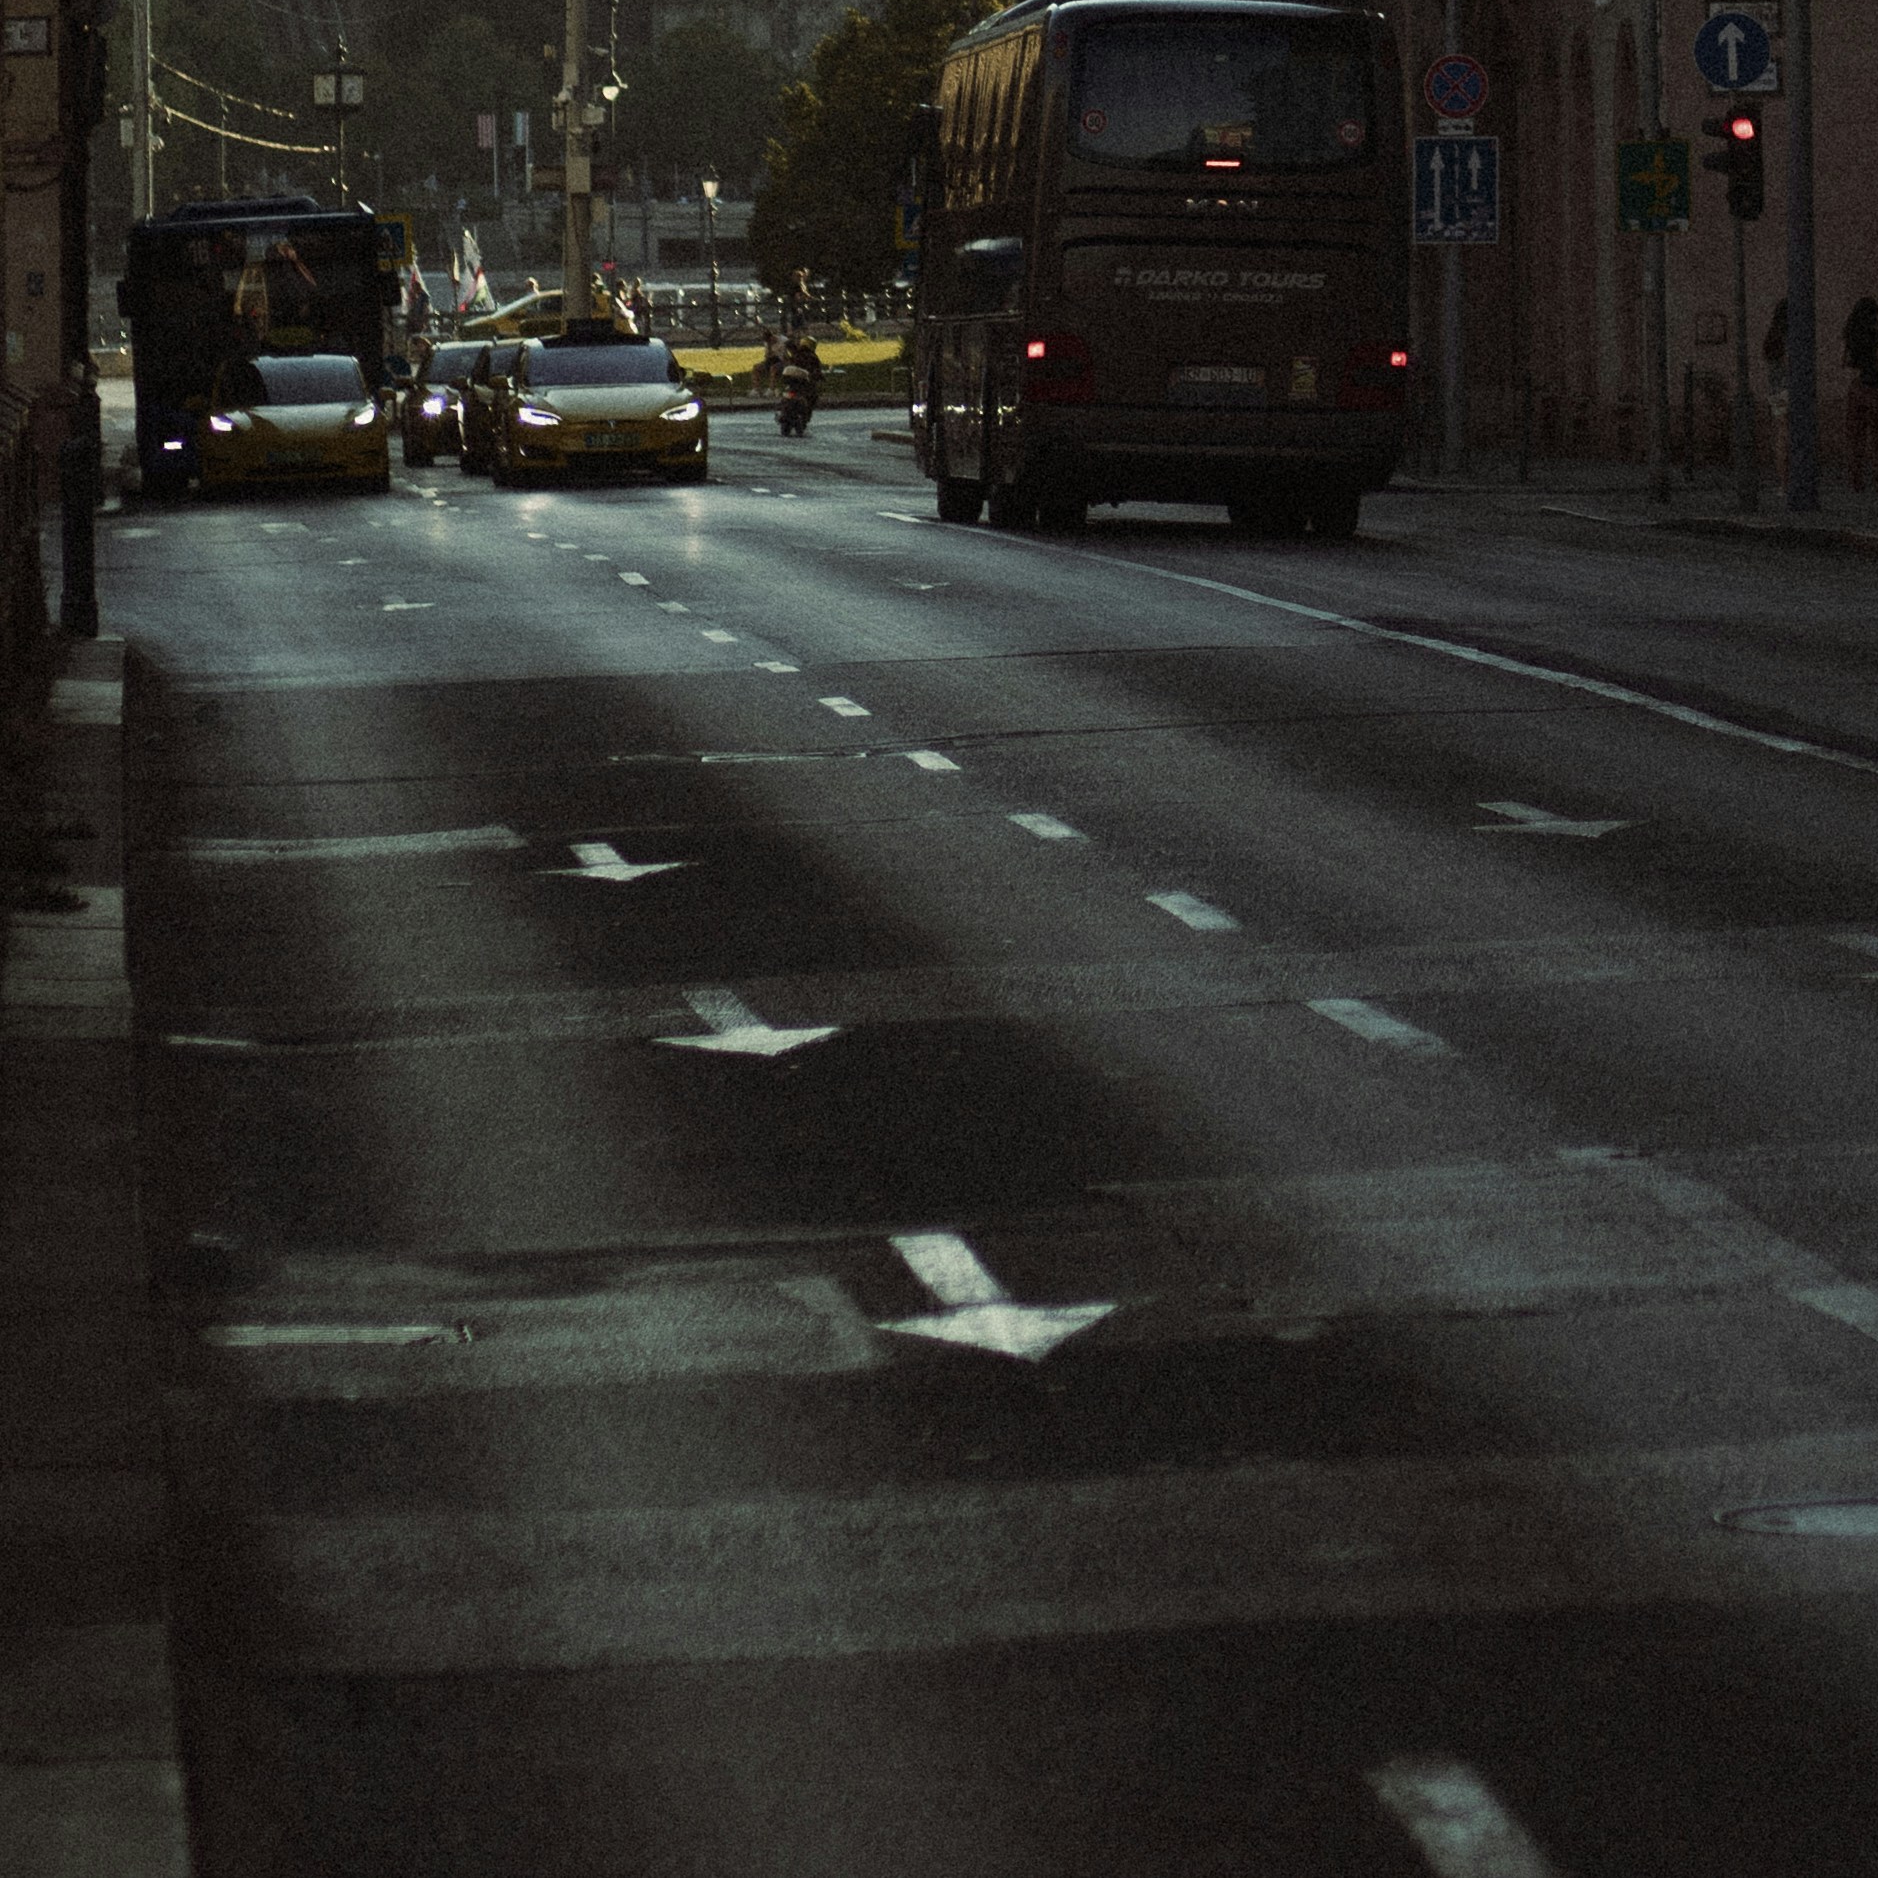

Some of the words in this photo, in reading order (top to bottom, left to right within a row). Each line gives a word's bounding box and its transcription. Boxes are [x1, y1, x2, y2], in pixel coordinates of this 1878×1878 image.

[1136, 269, 1229, 287] DARKO
[1236, 271, 1328, 290] TOURS
[1222, 292, 1284, 304] CROATIA
